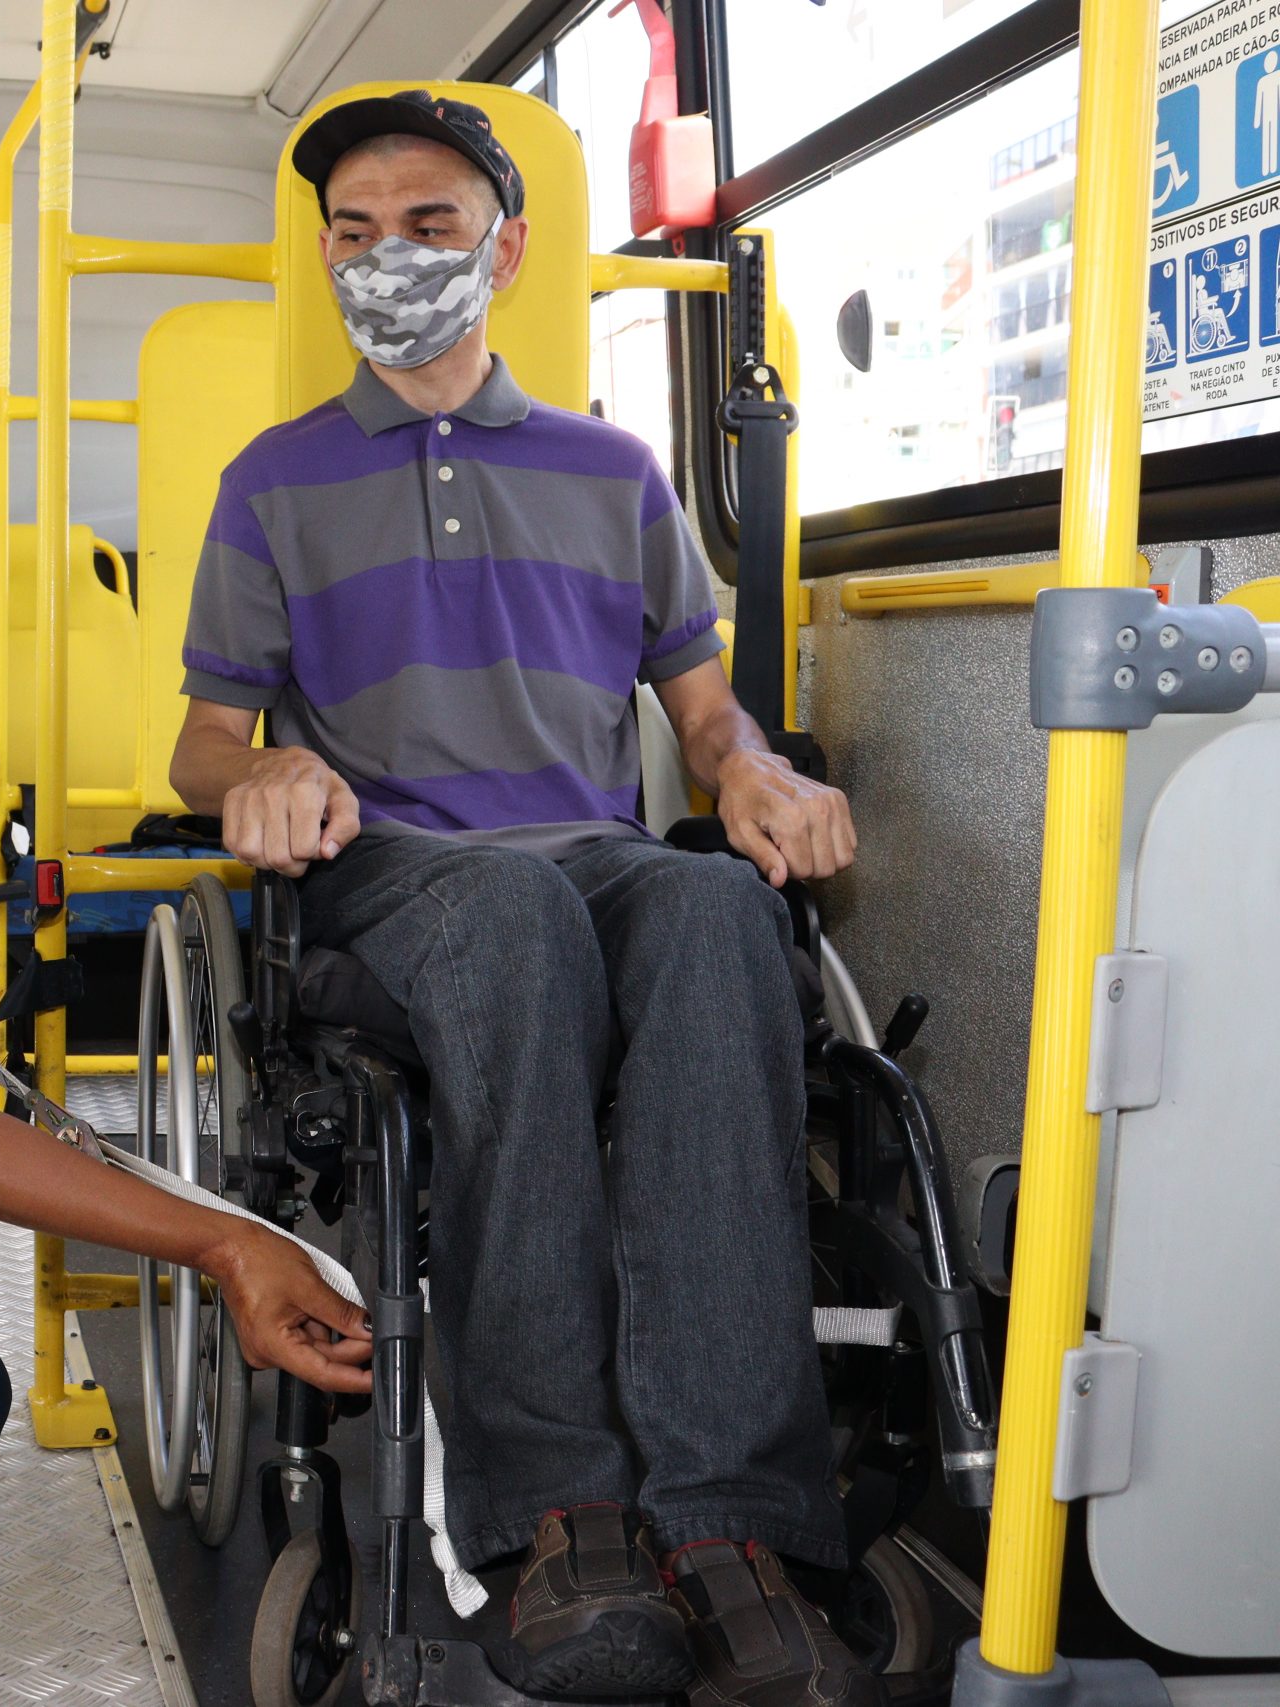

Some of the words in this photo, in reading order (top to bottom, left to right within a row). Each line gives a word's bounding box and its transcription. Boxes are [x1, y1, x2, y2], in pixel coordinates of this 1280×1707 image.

[1159, 13, 1215, 51] ESERVADA
[1217, 0, 1246, 22] PARA
[1183, 43, 1198, 61] EM
[1201, 20, 1248, 52] CADEIRA
[1250, 10, 1266, 29] DE
[1157, 56, 1223, 95] OMPANHADA
[1225, 47, 1240, 65] DE
[1209, 213, 1227, 232] DE
[1231, 196, 1280, 225] SEGUR
[1189, 367, 1213, 380] TRAVE
[1214, 366, 1221, 375] O
[1222, 360, 1246, 374] CINTO
[1261, 366, 1273, 378] DE
[1190, 383, 1201, 392] NA
[1202, 375, 1231, 390] REGIÃO
[1233, 373, 1244, 383] DA
[1272, 378, 1278, 388] E
[1206, 389, 1228, 400] RODA
